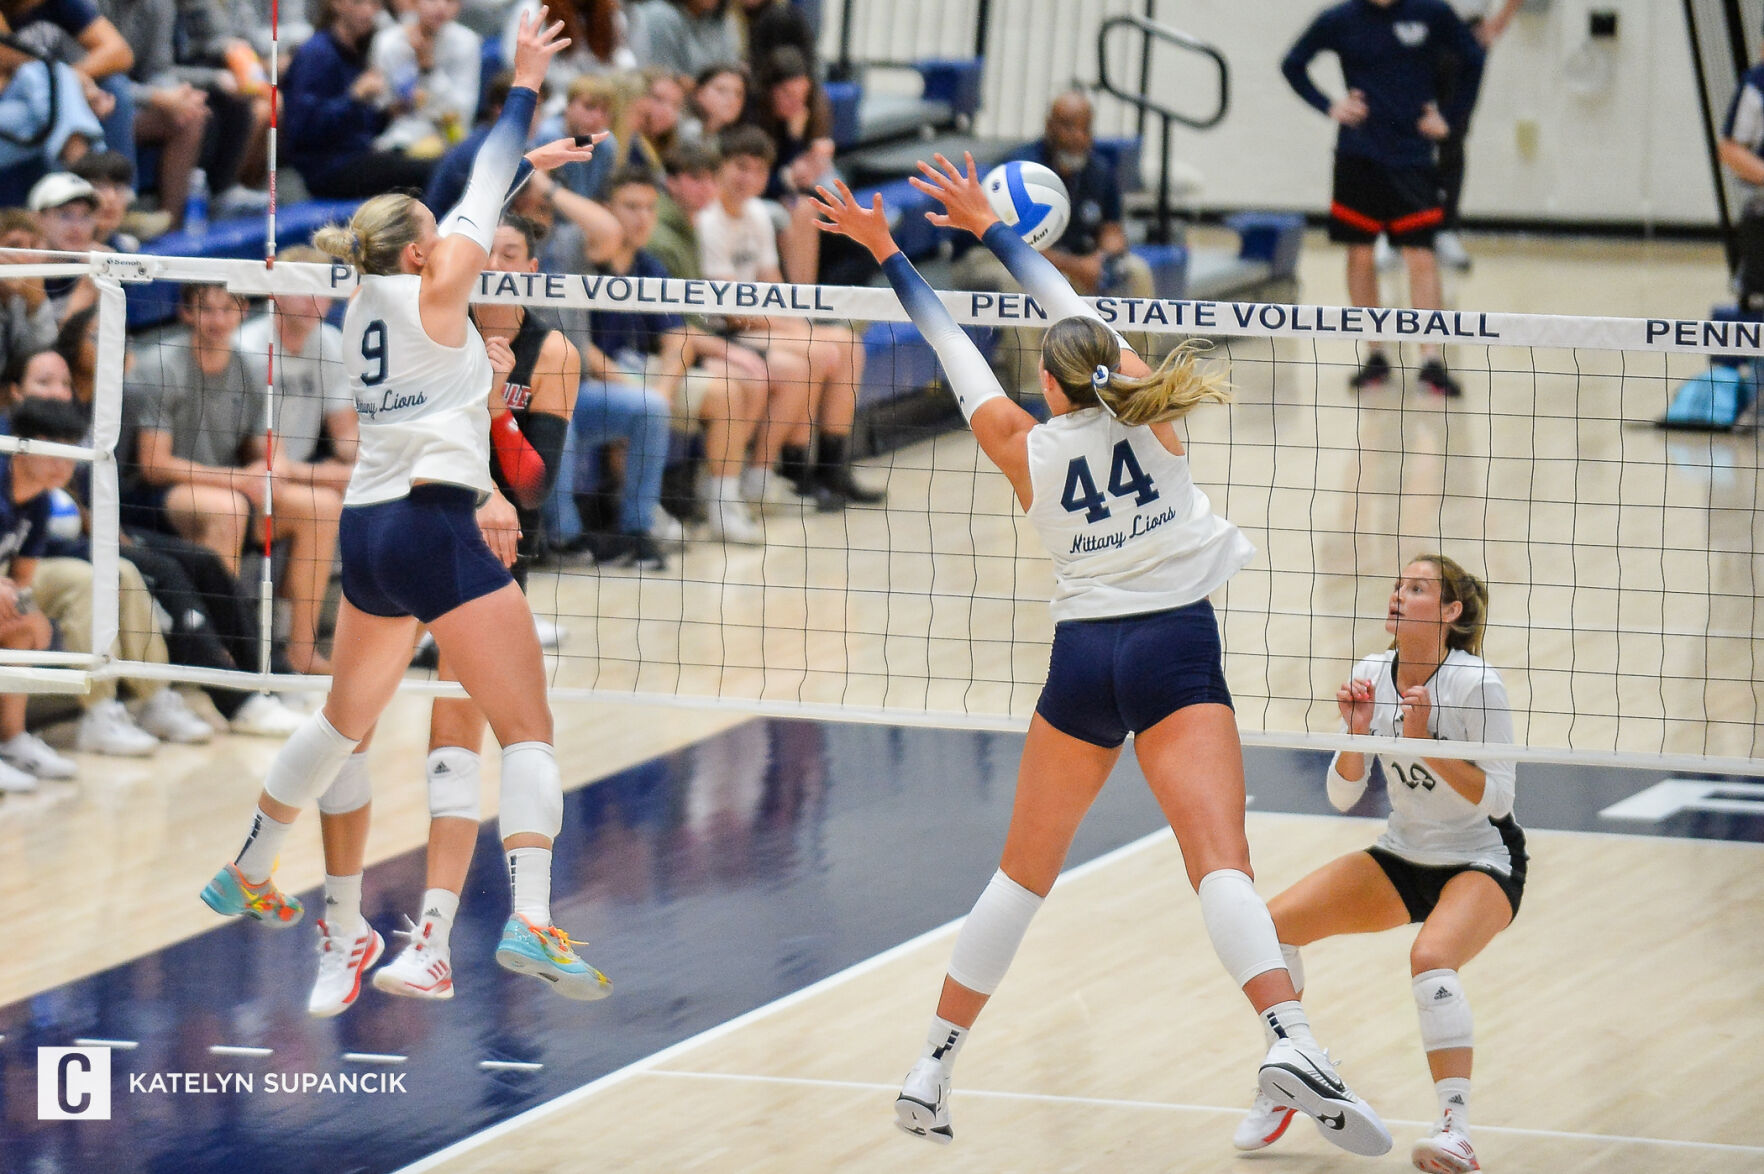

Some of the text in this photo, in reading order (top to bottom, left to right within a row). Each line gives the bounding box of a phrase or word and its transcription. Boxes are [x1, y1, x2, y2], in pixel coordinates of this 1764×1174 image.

[480, 272, 834, 311] TATE VOLLEYBALL
[971, 293, 1500, 338] PEN STATE VOLLEYBALL
[1646, 319, 1761, 348] PENN
[360, 319, 389, 387] 9
[379, 389, 428, 412] Lions
[1060, 438, 1160, 524] 44
[1128, 506, 1176, 539] Lions
